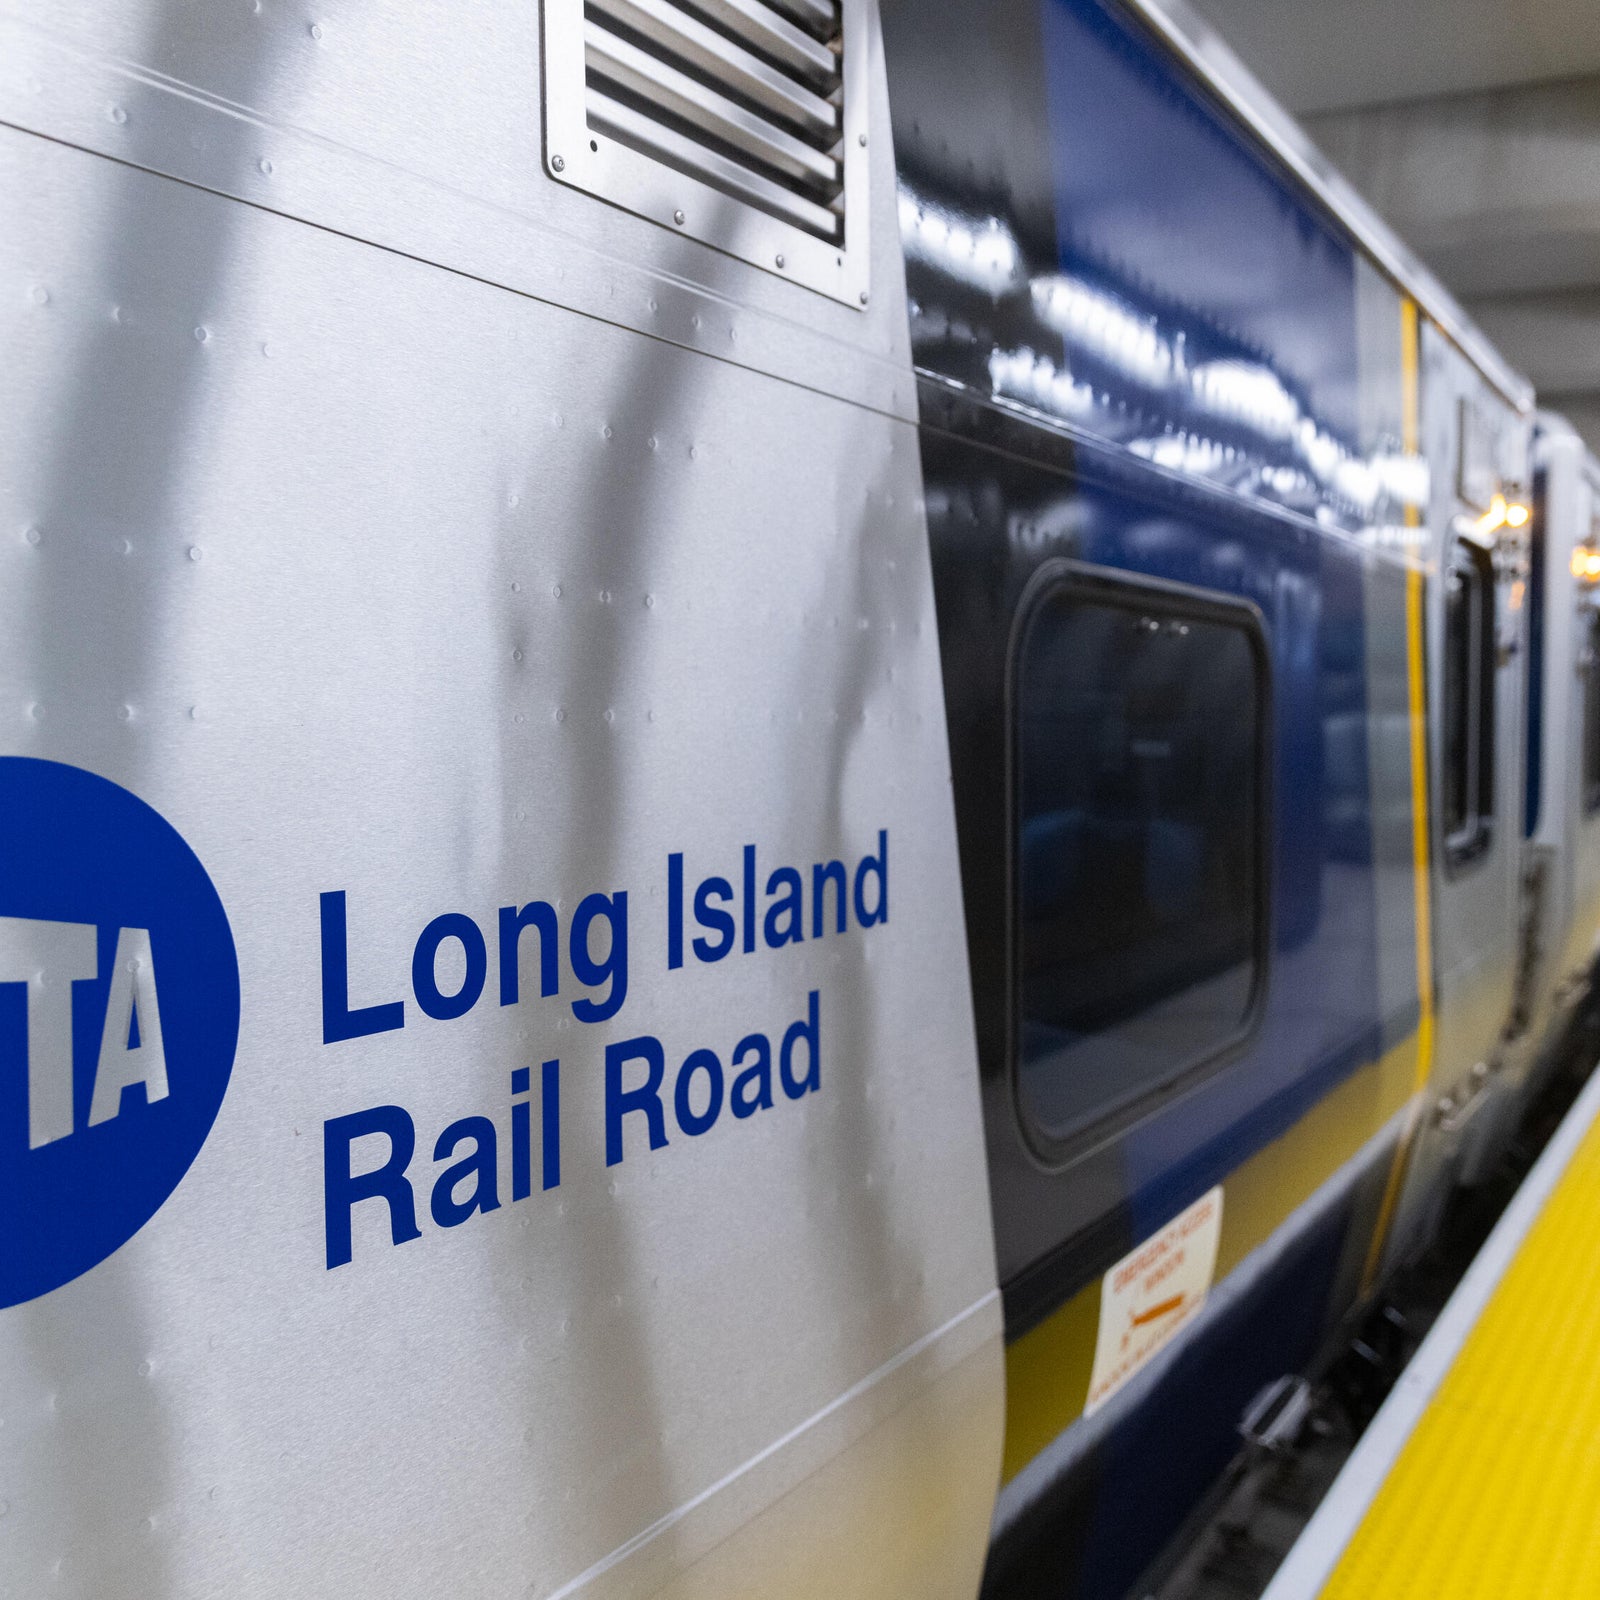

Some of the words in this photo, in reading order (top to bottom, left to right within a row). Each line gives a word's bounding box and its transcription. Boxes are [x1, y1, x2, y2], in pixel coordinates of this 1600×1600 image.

[319, 889, 629, 1045] Long
[667, 829, 889, 971] Island
[323, 1059, 561, 1271] Rail
[604, 990, 821, 1168] Road
